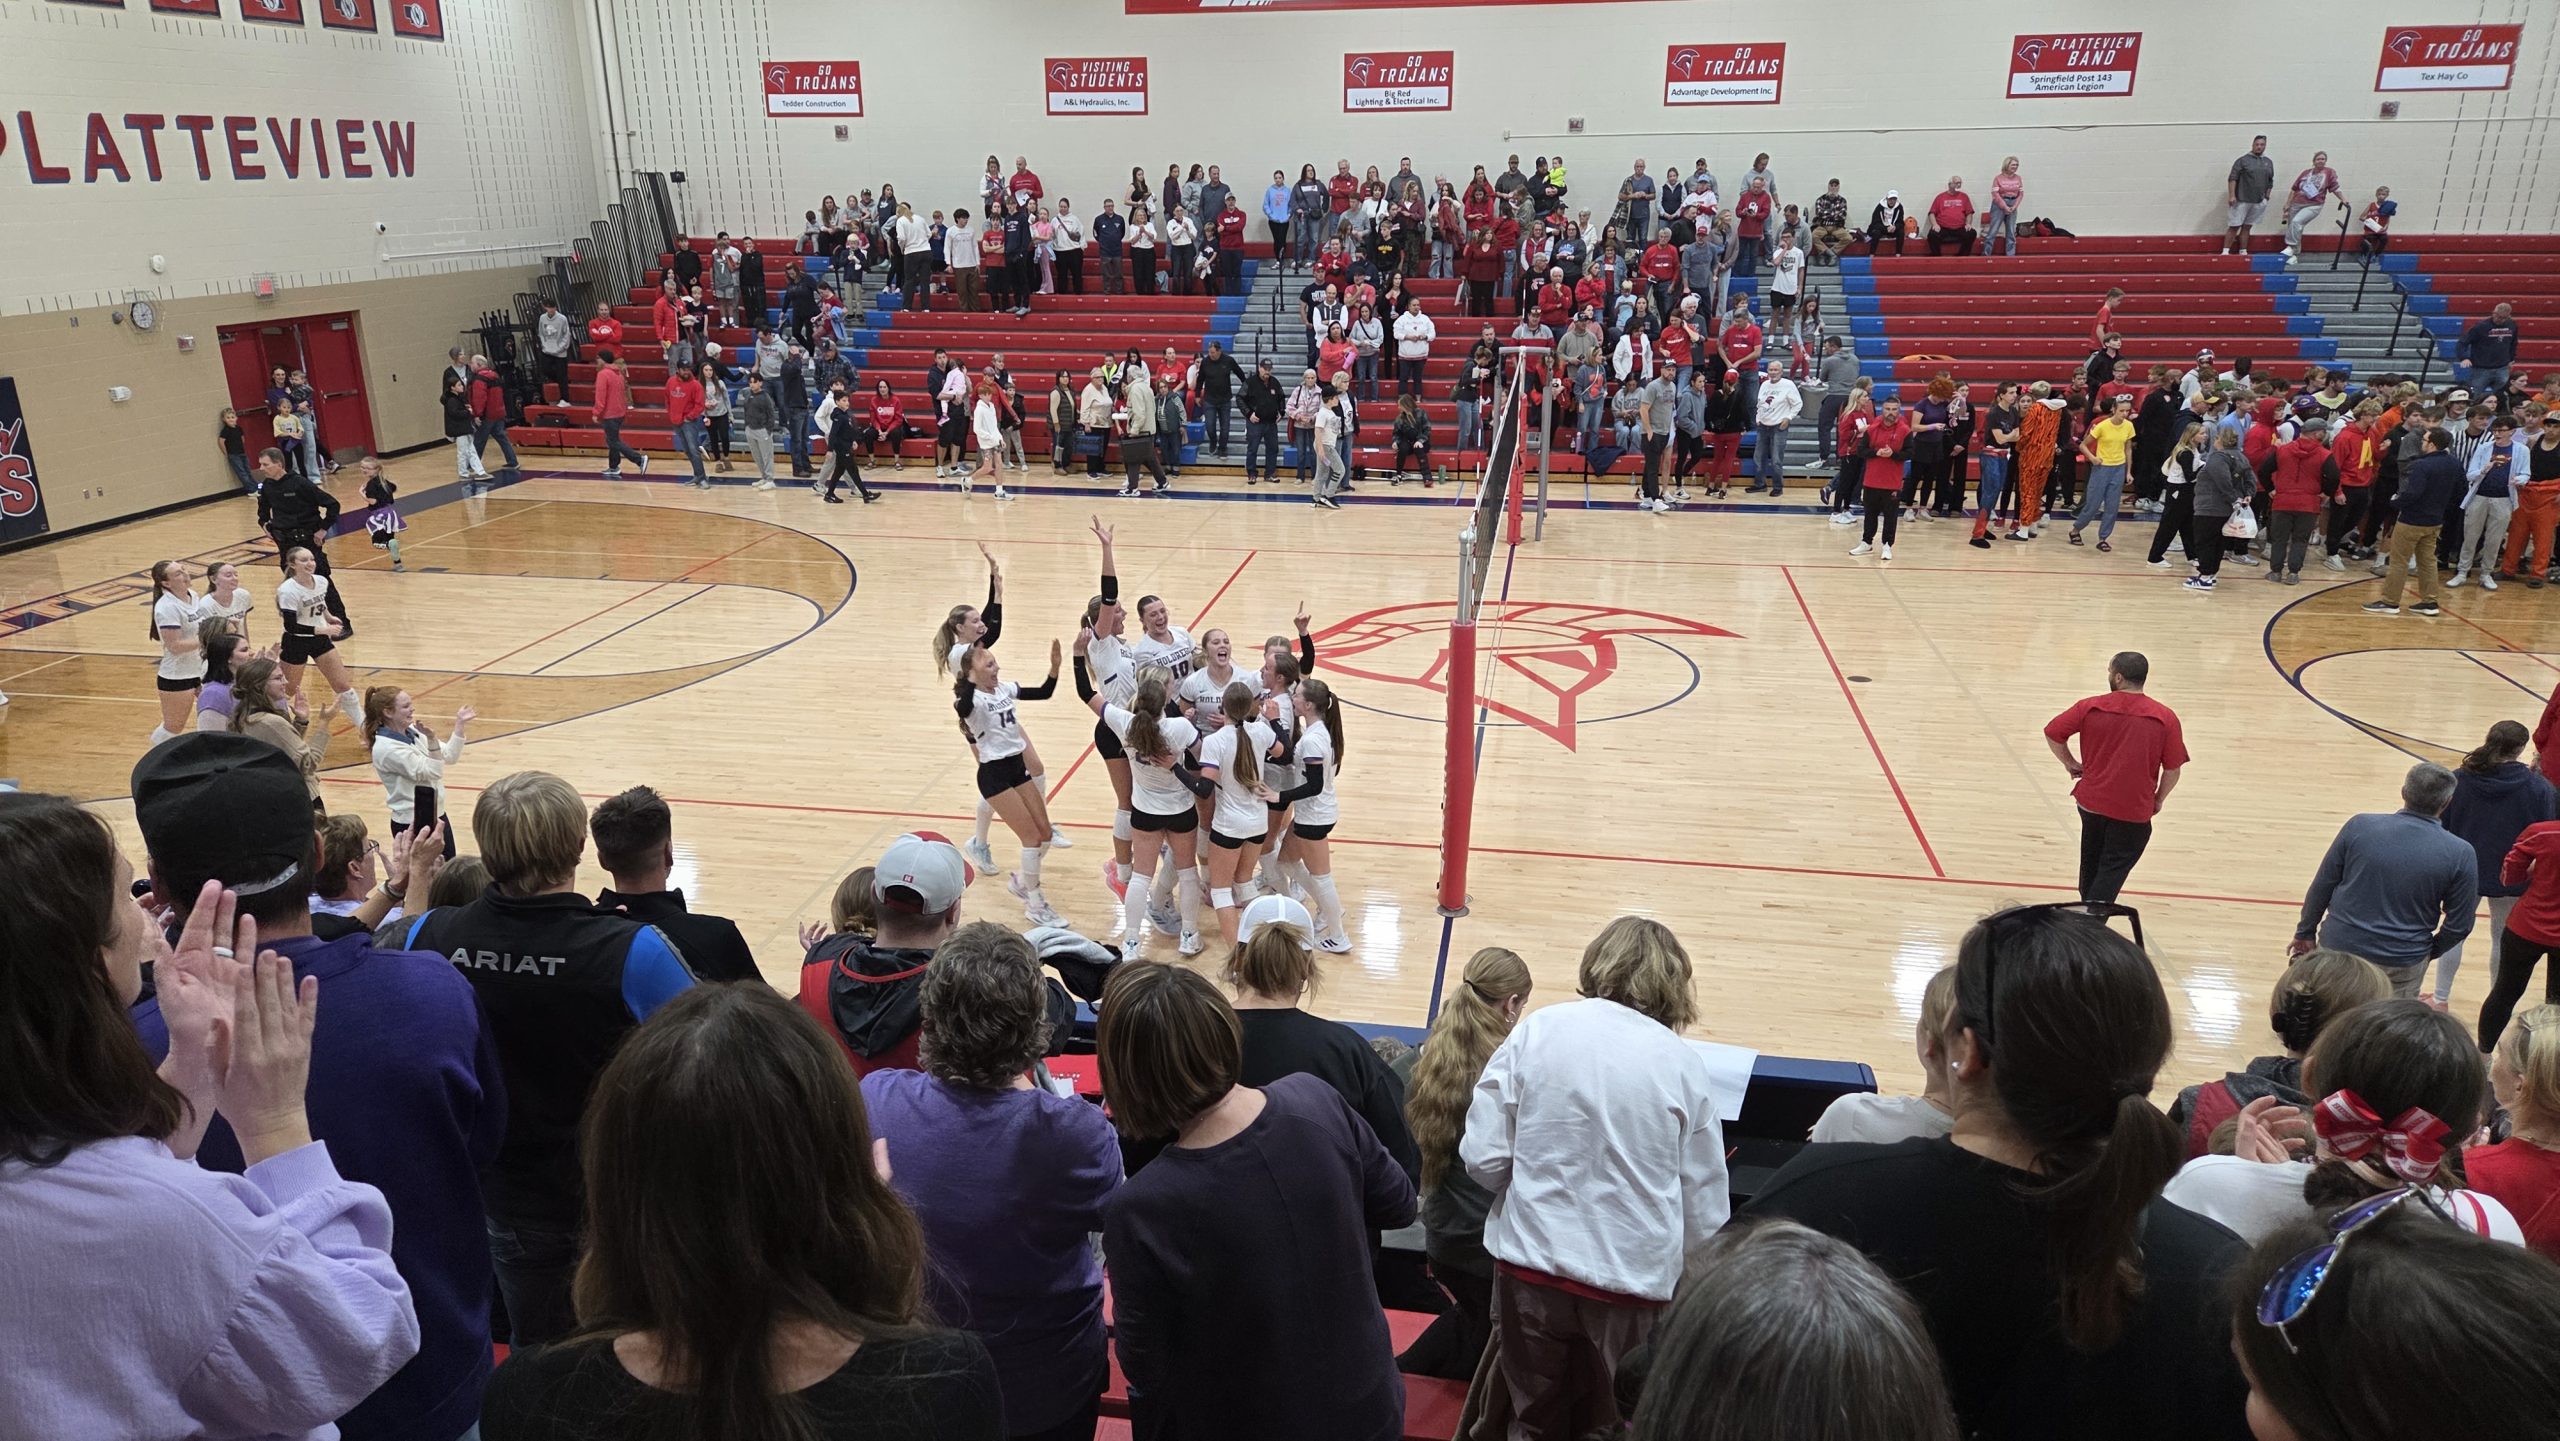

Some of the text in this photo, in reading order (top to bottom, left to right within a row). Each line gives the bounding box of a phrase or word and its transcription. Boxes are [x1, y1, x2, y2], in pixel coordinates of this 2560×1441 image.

[2462, 29, 2482, 42] GO
[2052, 36, 2136, 50] PLATTEVIEW
[1734, 47, 1752, 60] GO
[2424, 41, 2513, 60] TROJANS
[1407, 55, 1423, 67] GO
[2067, 50, 2116, 66] BAND
[818, 64, 832, 76] GO
[1082, 61, 1131, 73] VISITING
[1704, 59, 1780, 76] TROJANS
[1070, 72, 1144, 88] STUDENTS
[1379, 67, 1449, 83] TROJANS
[2030, 73, 2113, 85] Springfield Post 143
[2421, 71, 2469, 82] Tex Hay Co
[795, 76, 857, 90] TROJANS
[2035, 82, 2105, 92] American Legion
[1384, 89, 1411, 99] Big Red
[1671, 86, 1773, 97] Advantage Development Inc.
[782, 99, 847, 108] Tedder Construction
[1064, 98, 1131, 108] A&L Hydraulics, Inc.
[1355, 98, 1384, 107] Lighting
[1393, 97, 1425, 105] Electrical
[1427, 97, 1440, 105] Inc.
[0, 111, 415, 184] LATTEVIEW
[999, 708, 1016, 728] 14
[449, 947, 566, 976] ARIAT
